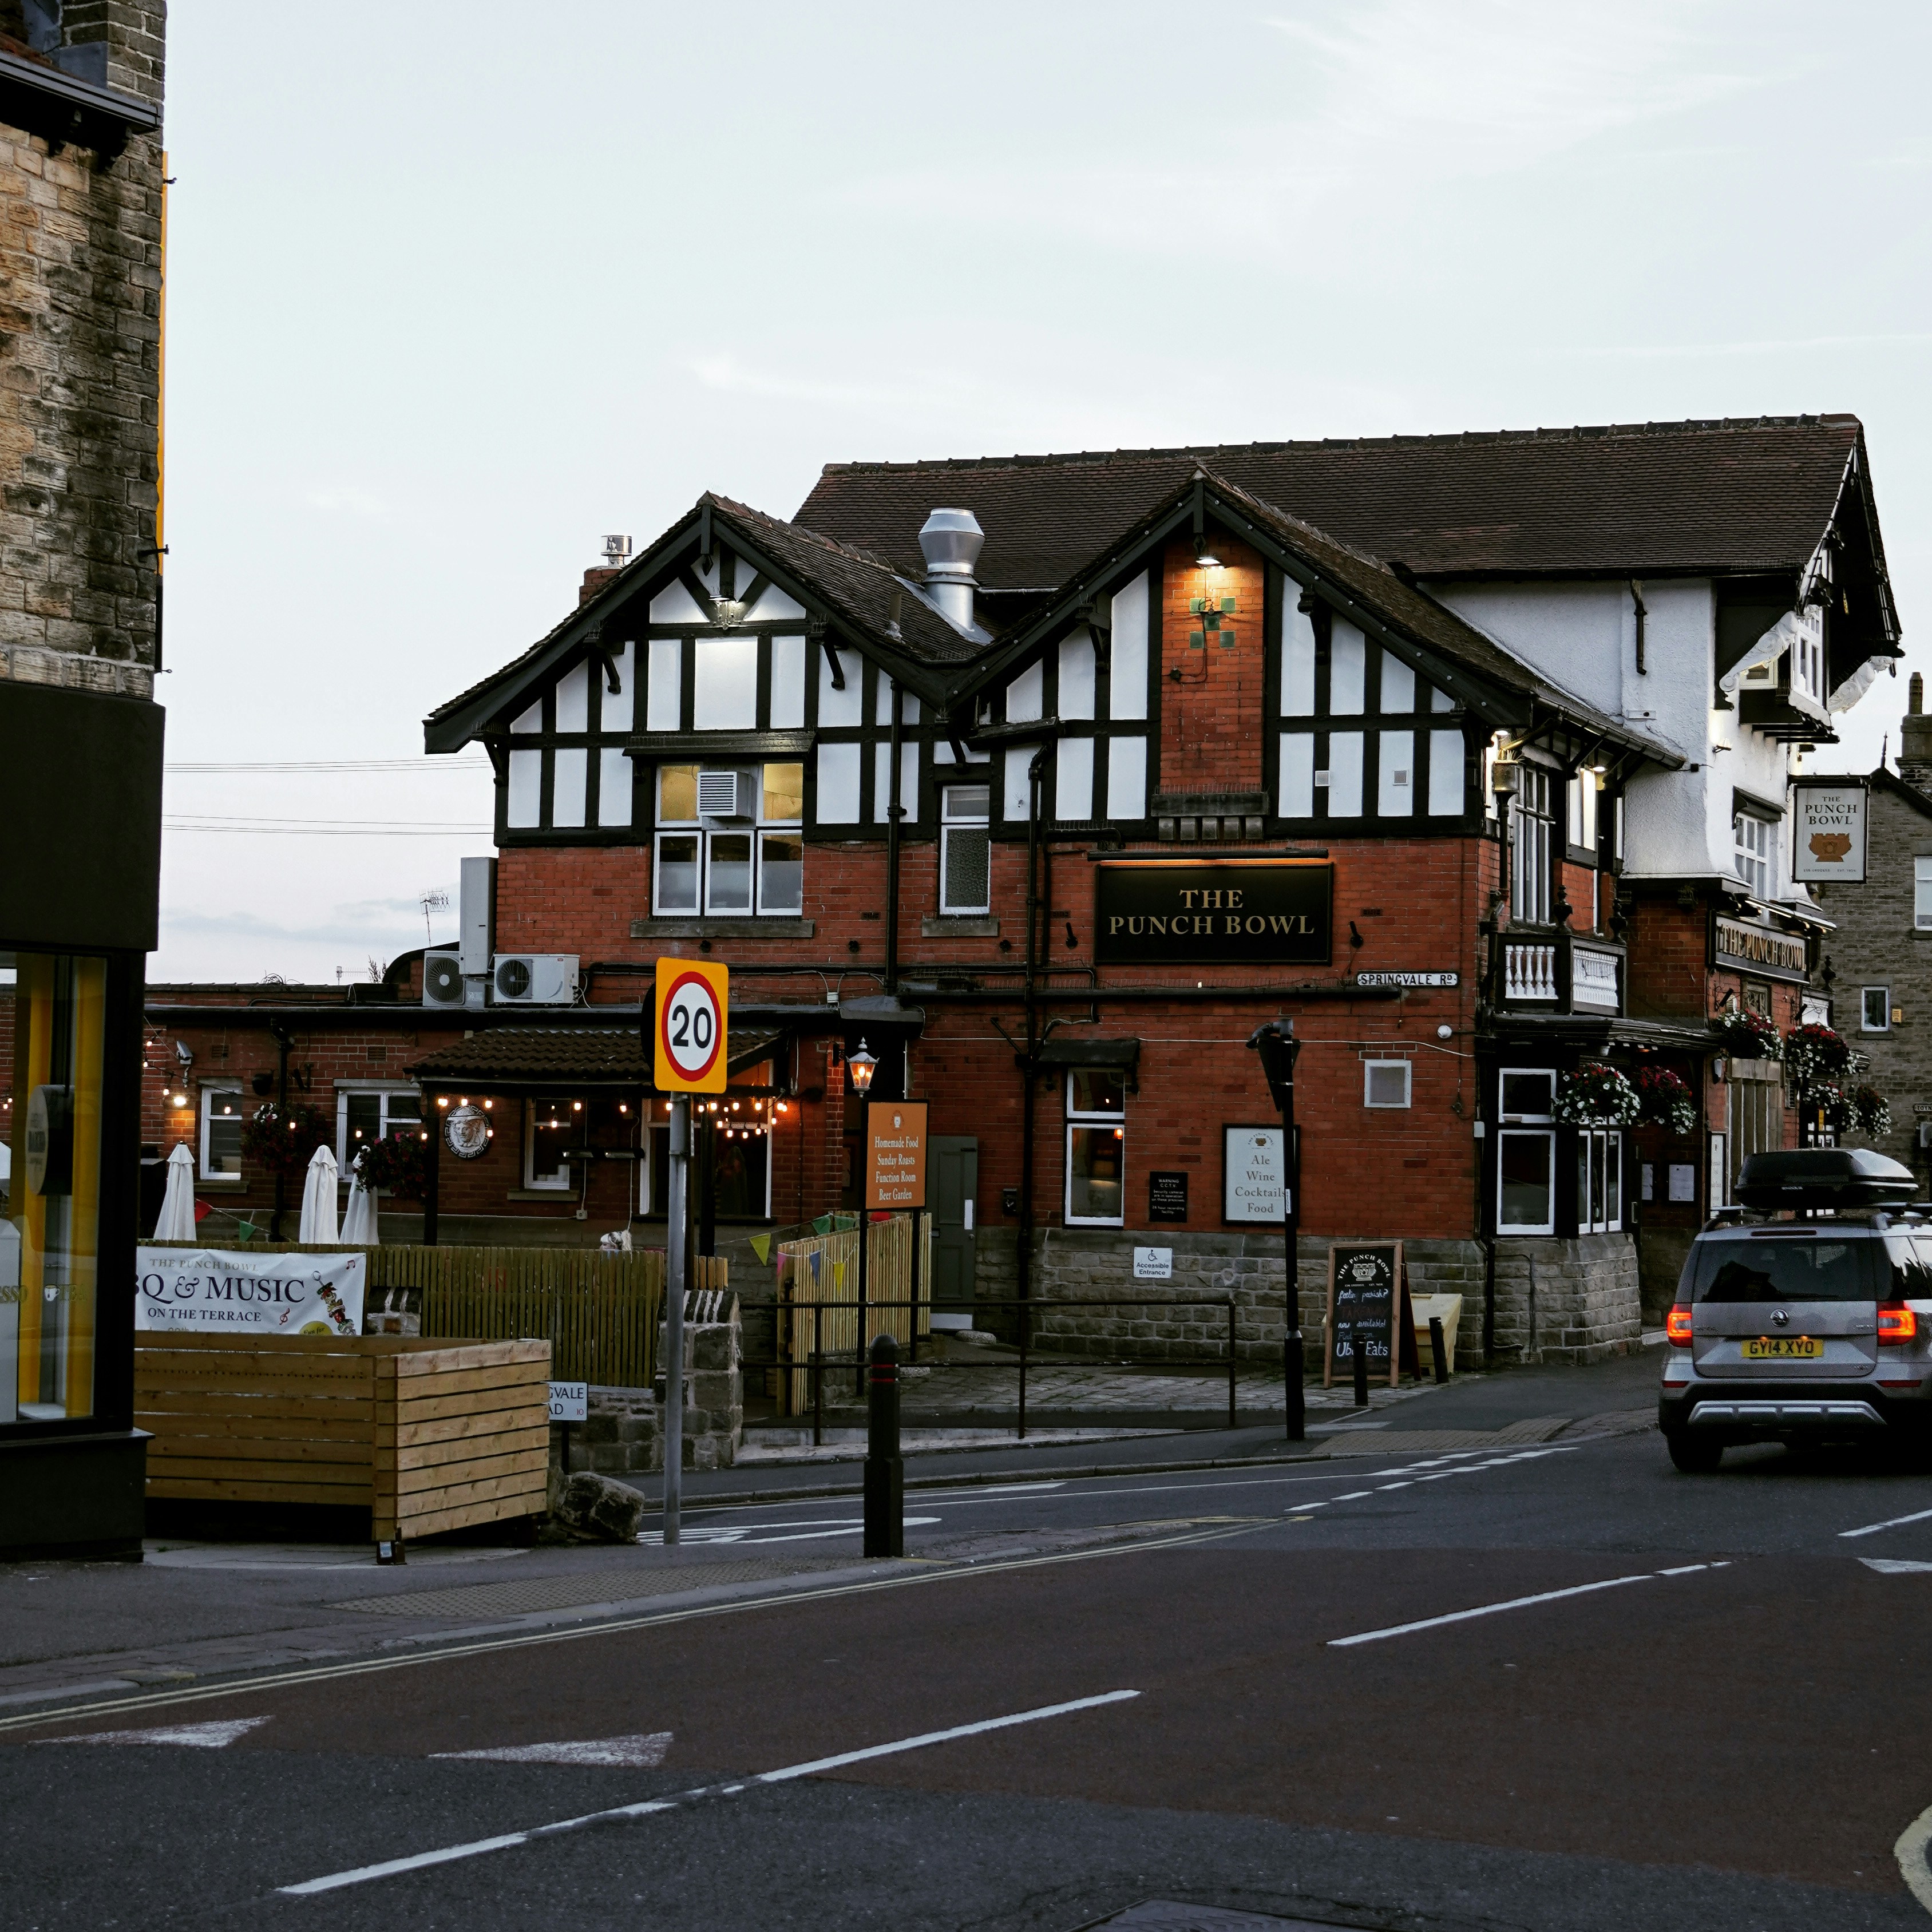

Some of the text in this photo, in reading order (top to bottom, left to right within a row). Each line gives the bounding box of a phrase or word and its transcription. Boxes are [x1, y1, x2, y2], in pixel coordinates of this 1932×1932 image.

[1805, 804, 1857, 813] PUNCH
[1808, 816, 1852, 825] BOWL
[1179, 890, 1244, 909] THE
[1109, 916, 1315, 935] PUNCH BOWL
[1722, 924, 1807, 972] THE PUNCH BOWL
[1361, 975, 1432, 985] SPRINGVALE
[672, 1004, 712, 1049] 20
[875, 1136, 919, 1148] Homemade Food
[878, 1154, 915, 1169] Sunday Roasts
[1251, 1154, 1270, 1165] Ale
[876, 1171, 916, 1183] Function Room
[1246, 1171, 1275, 1181] Wine
[879, 1188, 912, 1201] Beer Garden
[1235, 1186, 1285, 1197] Cocktails
[1248, 1202, 1274, 1213] Food
[149, 1258, 259, 1272] THE PUNCH BOWL
[1338, 1254, 1391, 1280] THE PUNCH BOWL
[175, 1276, 200, 1298] &
[205, 1276, 306, 1303] MUSIC
[148, 1307, 262, 1322] ON THE TERRACE
[1365, 1341, 1388, 1356] Eats
[1749, 1341, 1781, 1354] GY14
